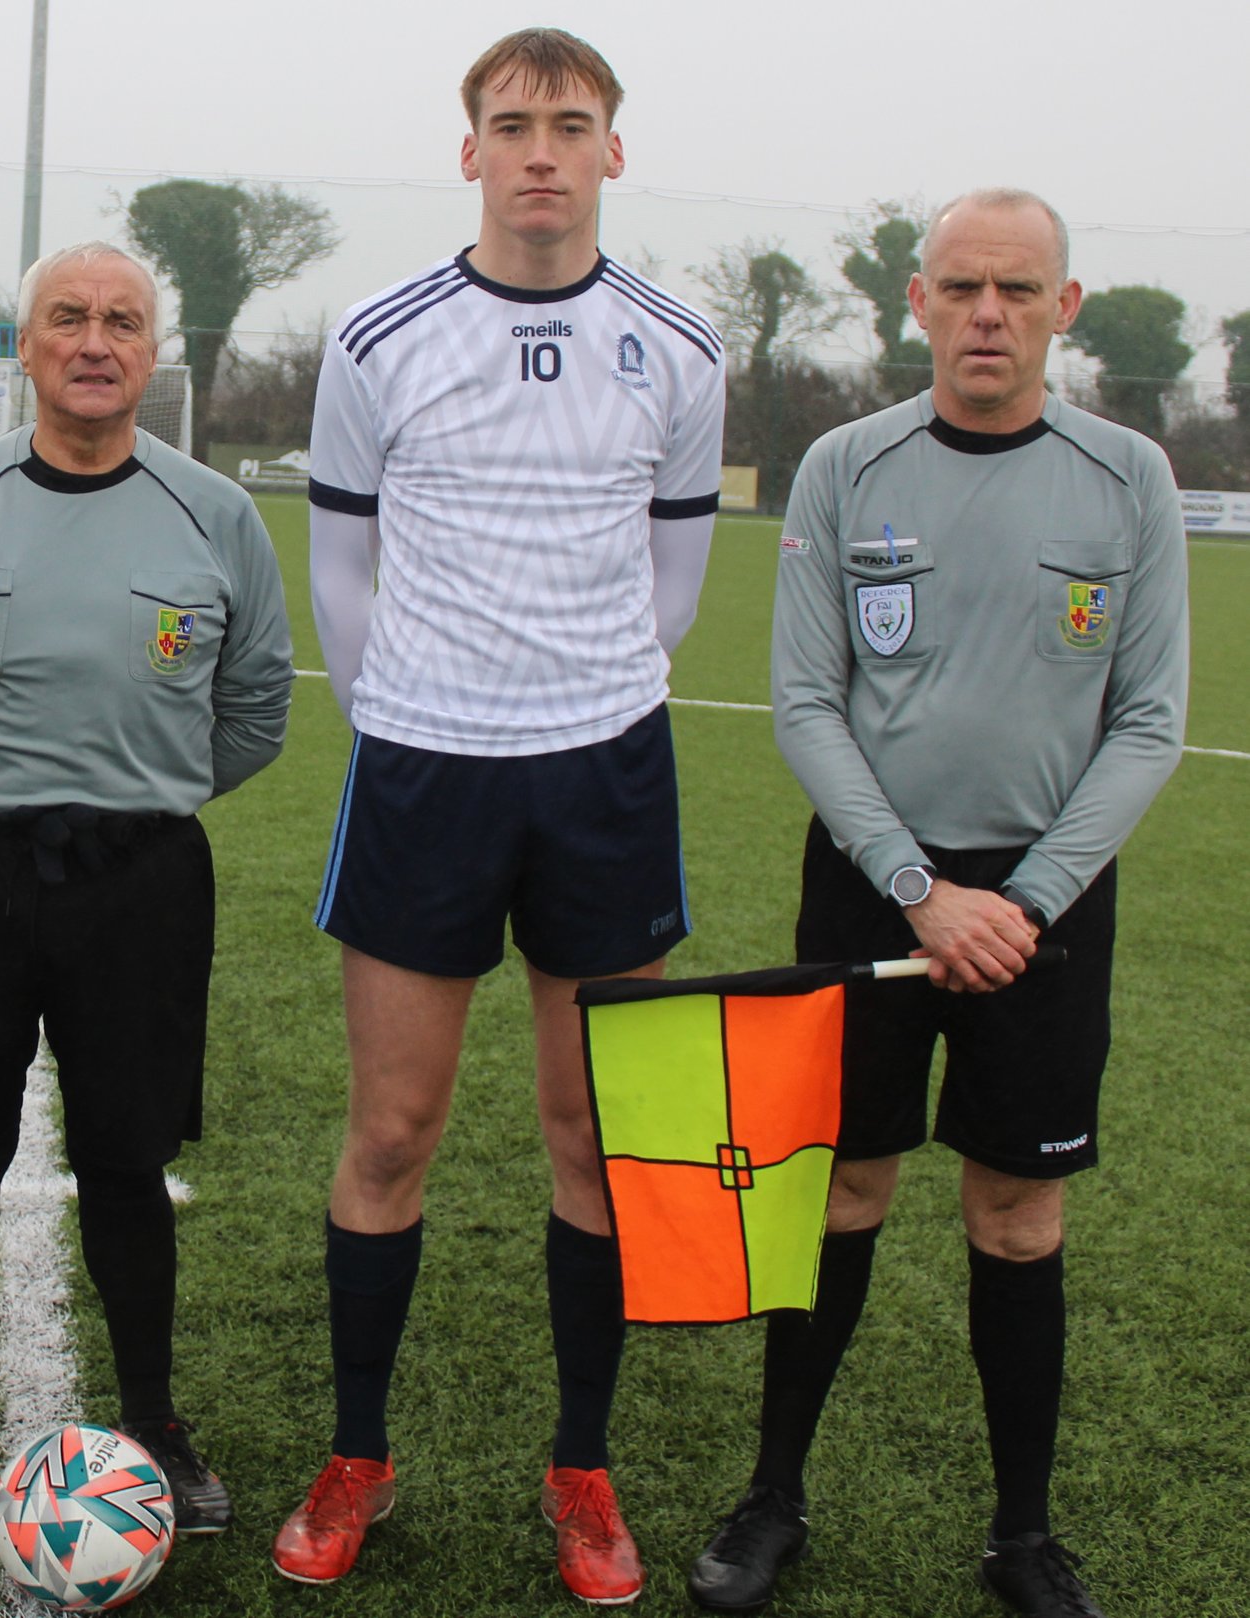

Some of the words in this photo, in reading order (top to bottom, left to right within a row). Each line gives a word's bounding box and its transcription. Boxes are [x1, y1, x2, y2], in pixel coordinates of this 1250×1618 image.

[521, 342, 561, 382] 10
[860, 586, 911, 598] REFEREE
[877, 601, 892, 610] FAI
[1040, 1133, 1088, 1152] STANNO
[89, 1435, 121, 1474] mitre
